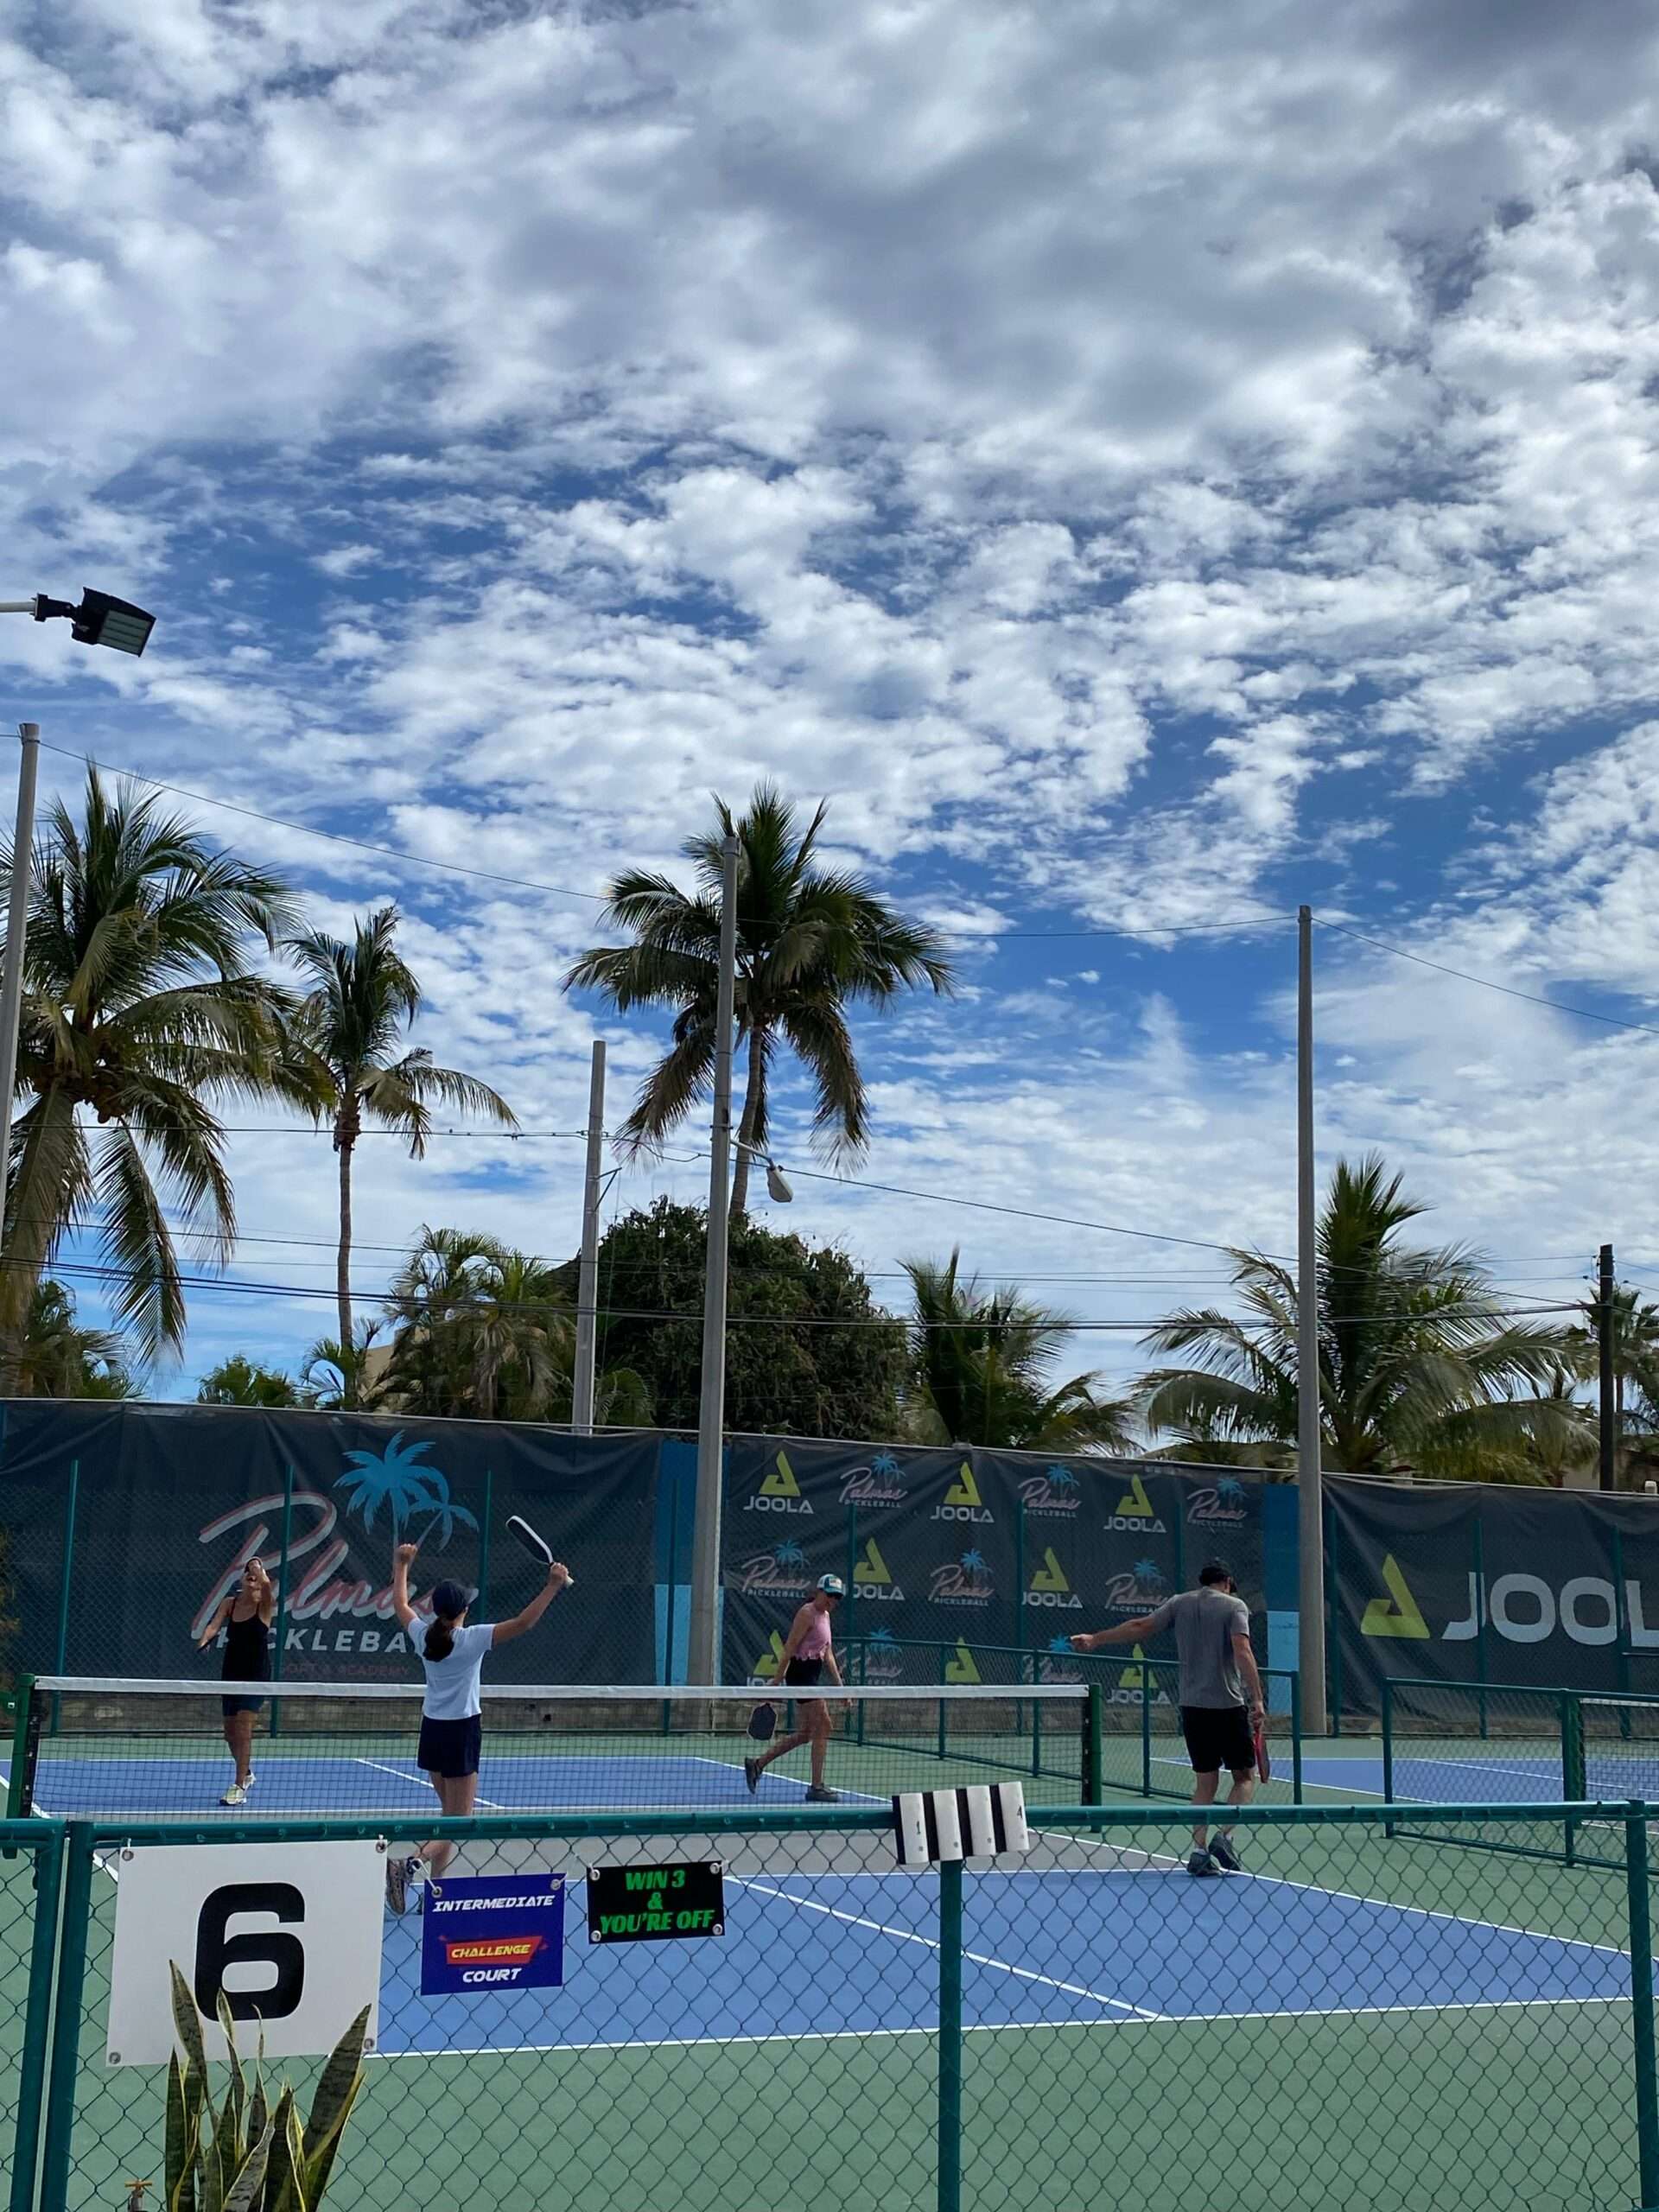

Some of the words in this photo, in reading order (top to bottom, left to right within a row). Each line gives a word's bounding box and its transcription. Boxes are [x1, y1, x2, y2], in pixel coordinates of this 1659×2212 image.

[743, 1496, 814, 1514] JOOLA
[930, 1505, 994, 1523] JOOLA
[1103, 1516, 1166, 1533] JOOLA
[191, 1491, 479, 1640] Plmas
[1021, 1592, 1084, 1609] JOOLA
[625, 1871, 669, 1891] WIN
[671, 1869, 686, 1889] 3
[433, 1895, 556, 1912] INTERMEDIATE
[647, 1891, 664, 1910] &
[600, 1910, 674, 1935] YOU'RE
[676, 1909, 715, 1929] OFF
[194, 1882, 305, 2022] 6
[451, 1944, 531, 1958] CHALLENGE
[462, 1967, 523, 1983] COURT
